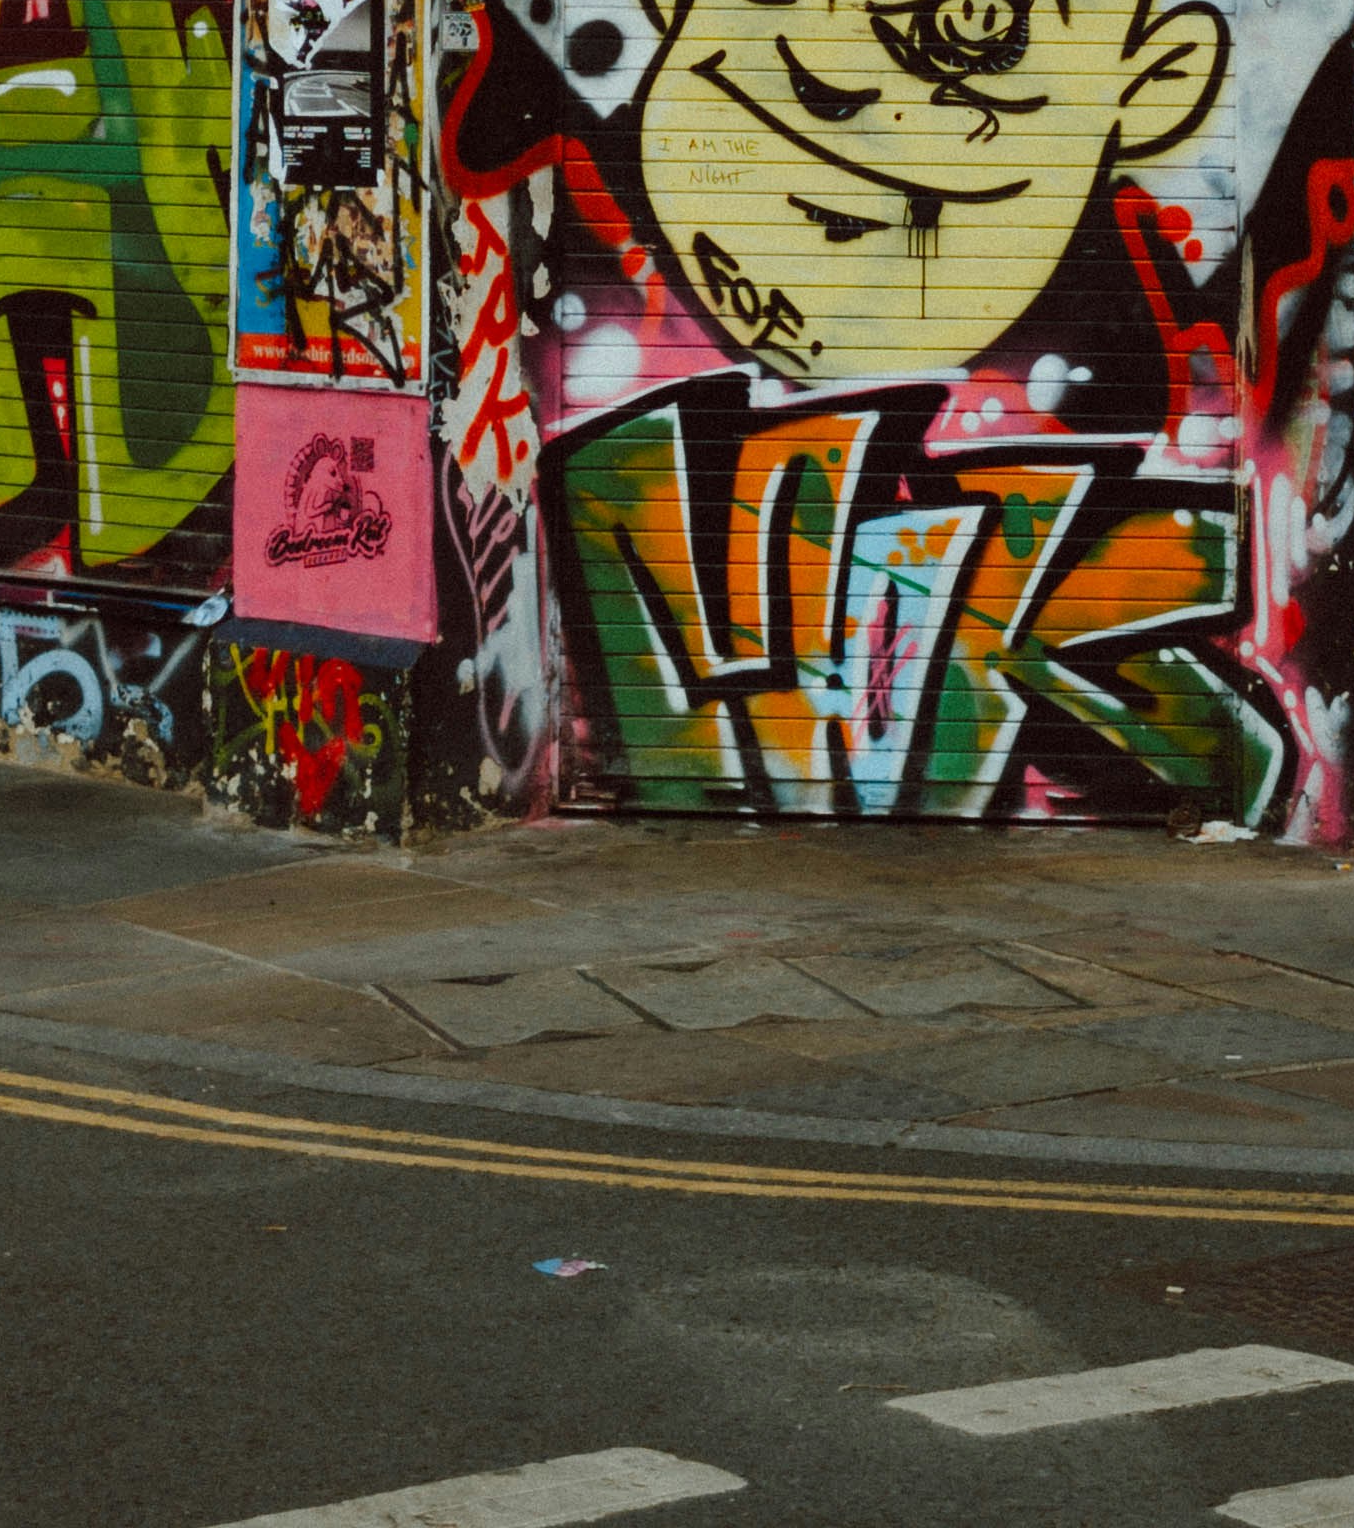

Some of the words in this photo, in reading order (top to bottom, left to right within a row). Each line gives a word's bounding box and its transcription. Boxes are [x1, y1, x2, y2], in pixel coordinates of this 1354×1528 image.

[659, 136, 672, 152] I
[689, 136, 717, 153] AM
[724, 138, 760, 156] THE
